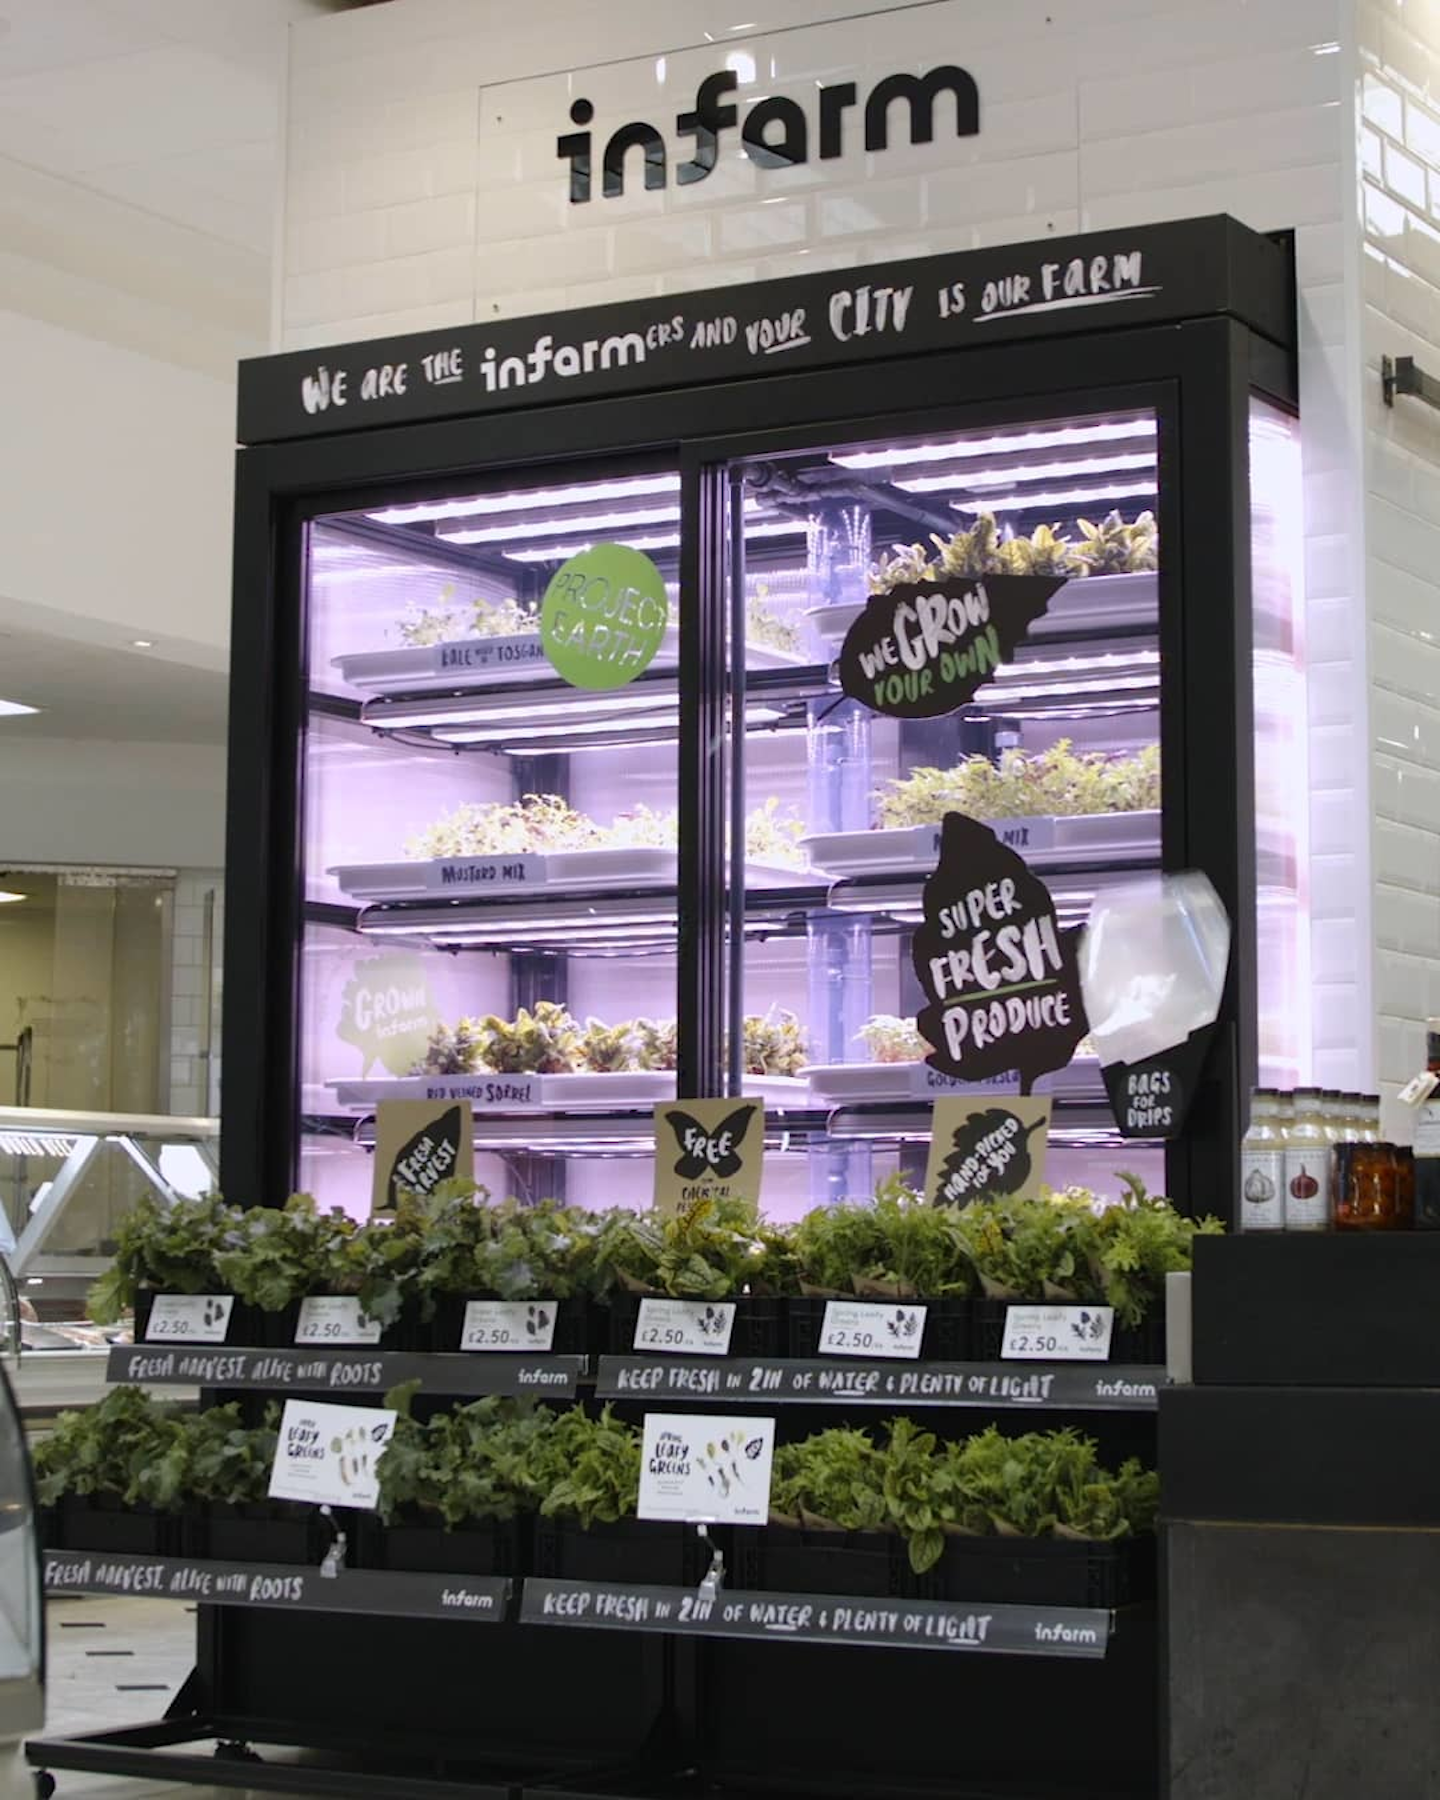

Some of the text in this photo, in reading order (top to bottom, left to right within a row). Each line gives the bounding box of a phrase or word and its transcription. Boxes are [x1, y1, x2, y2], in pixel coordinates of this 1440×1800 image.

[557, 64, 980, 203] infarm
[301, 366, 348, 415] WE
[361, 363, 408, 399] ARE
[420, 347, 463, 385] THE
[690, 316, 737, 349] AND
[744, 308, 812, 355] YOUR
[829, 284, 913, 341] CITY
[939, 287, 965, 320] IS
[980, 275, 1031, 313] OUR
[1040, 250, 1143, 300] FARM
[551, 610, 647, 666] EARTH
[858, 581, 990, 680] WE GROW
[874, 623, 1002, 706] YOUR OWN
[1003, 828, 1029, 847] MIX
[442, 862, 525, 884] MUSTARD MIX
[938, 877, 1022, 939] SUPER
[929, 914, 1063, 999] FRESH
[941, 991, 1071, 1062] PRODUCE
[427, 1087, 446, 1100] RED
[486, 1083, 532, 1102] SORREL
[1128, 1071, 1171, 1096] BAGS
[1133, 1094, 1156, 1109] FOR
[1127, 1105, 1173, 1128] DRIPS
[684, 1127, 733, 1164] FREE
[986, 1140, 1017, 1176] YOU
[972, 1164, 991, 1188] FOR
[469, 1329, 510, 1344] £2.50
[642, 1328, 684, 1345] £2.50
[828, 1331, 873, 1348] £2.50
[1010, 1336, 1057, 1351] £2.50
[128, 1354, 174, 1378] FRESH
[251, 1358, 293, 1382] ALIVE
[297, 1361, 327, 1378] WITH
[330, 1362, 383, 1388] ROOTS
[518, 1368, 568, 1385] infarm
[617, 1366, 664, 1390] KEEP
[669, 1367, 721, 1394] FRESH
[726, 1372, 742, 1388] IN
[748, 1366, 783, 1392] 2IN
[792, 1372, 813, 1390] OF
[818, 1370, 881, 1394] WATER
[900, 1371, 963, 1395] PLENTY
[968, 1376, 989, 1394] OF
[990, 1374, 1054, 1400] LIGHT
[1095, 1379, 1156, 1397] infarm
[288, 1443, 325, 1460] GREENS
[649, 1459, 691, 1475] GREENS
[44, 1560, 91, 1586] FRESH
[170, 1567, 211, 1594] ALIVE
[216, 1573, 246, 1592] WITH
[250, 1575, 304, 1601] ROOTS
[442, 1588, 493, 1609] infarm
[543, 1592, 590, 1616] KEEP
[595, 1594, 648, 1621] FRESH
[655, 1601, 670, 1618] IN
[724, 1604, 743, 1622] OF
[750, 1604, 811, 1628] WATER
[833, 1608, 898, 1632] PLENTY
[903, 1614, 923, 1632] OF
[926, 1615, 992, 1642] LIGHT
[1034, 1623, 1097, 1643] infarm
